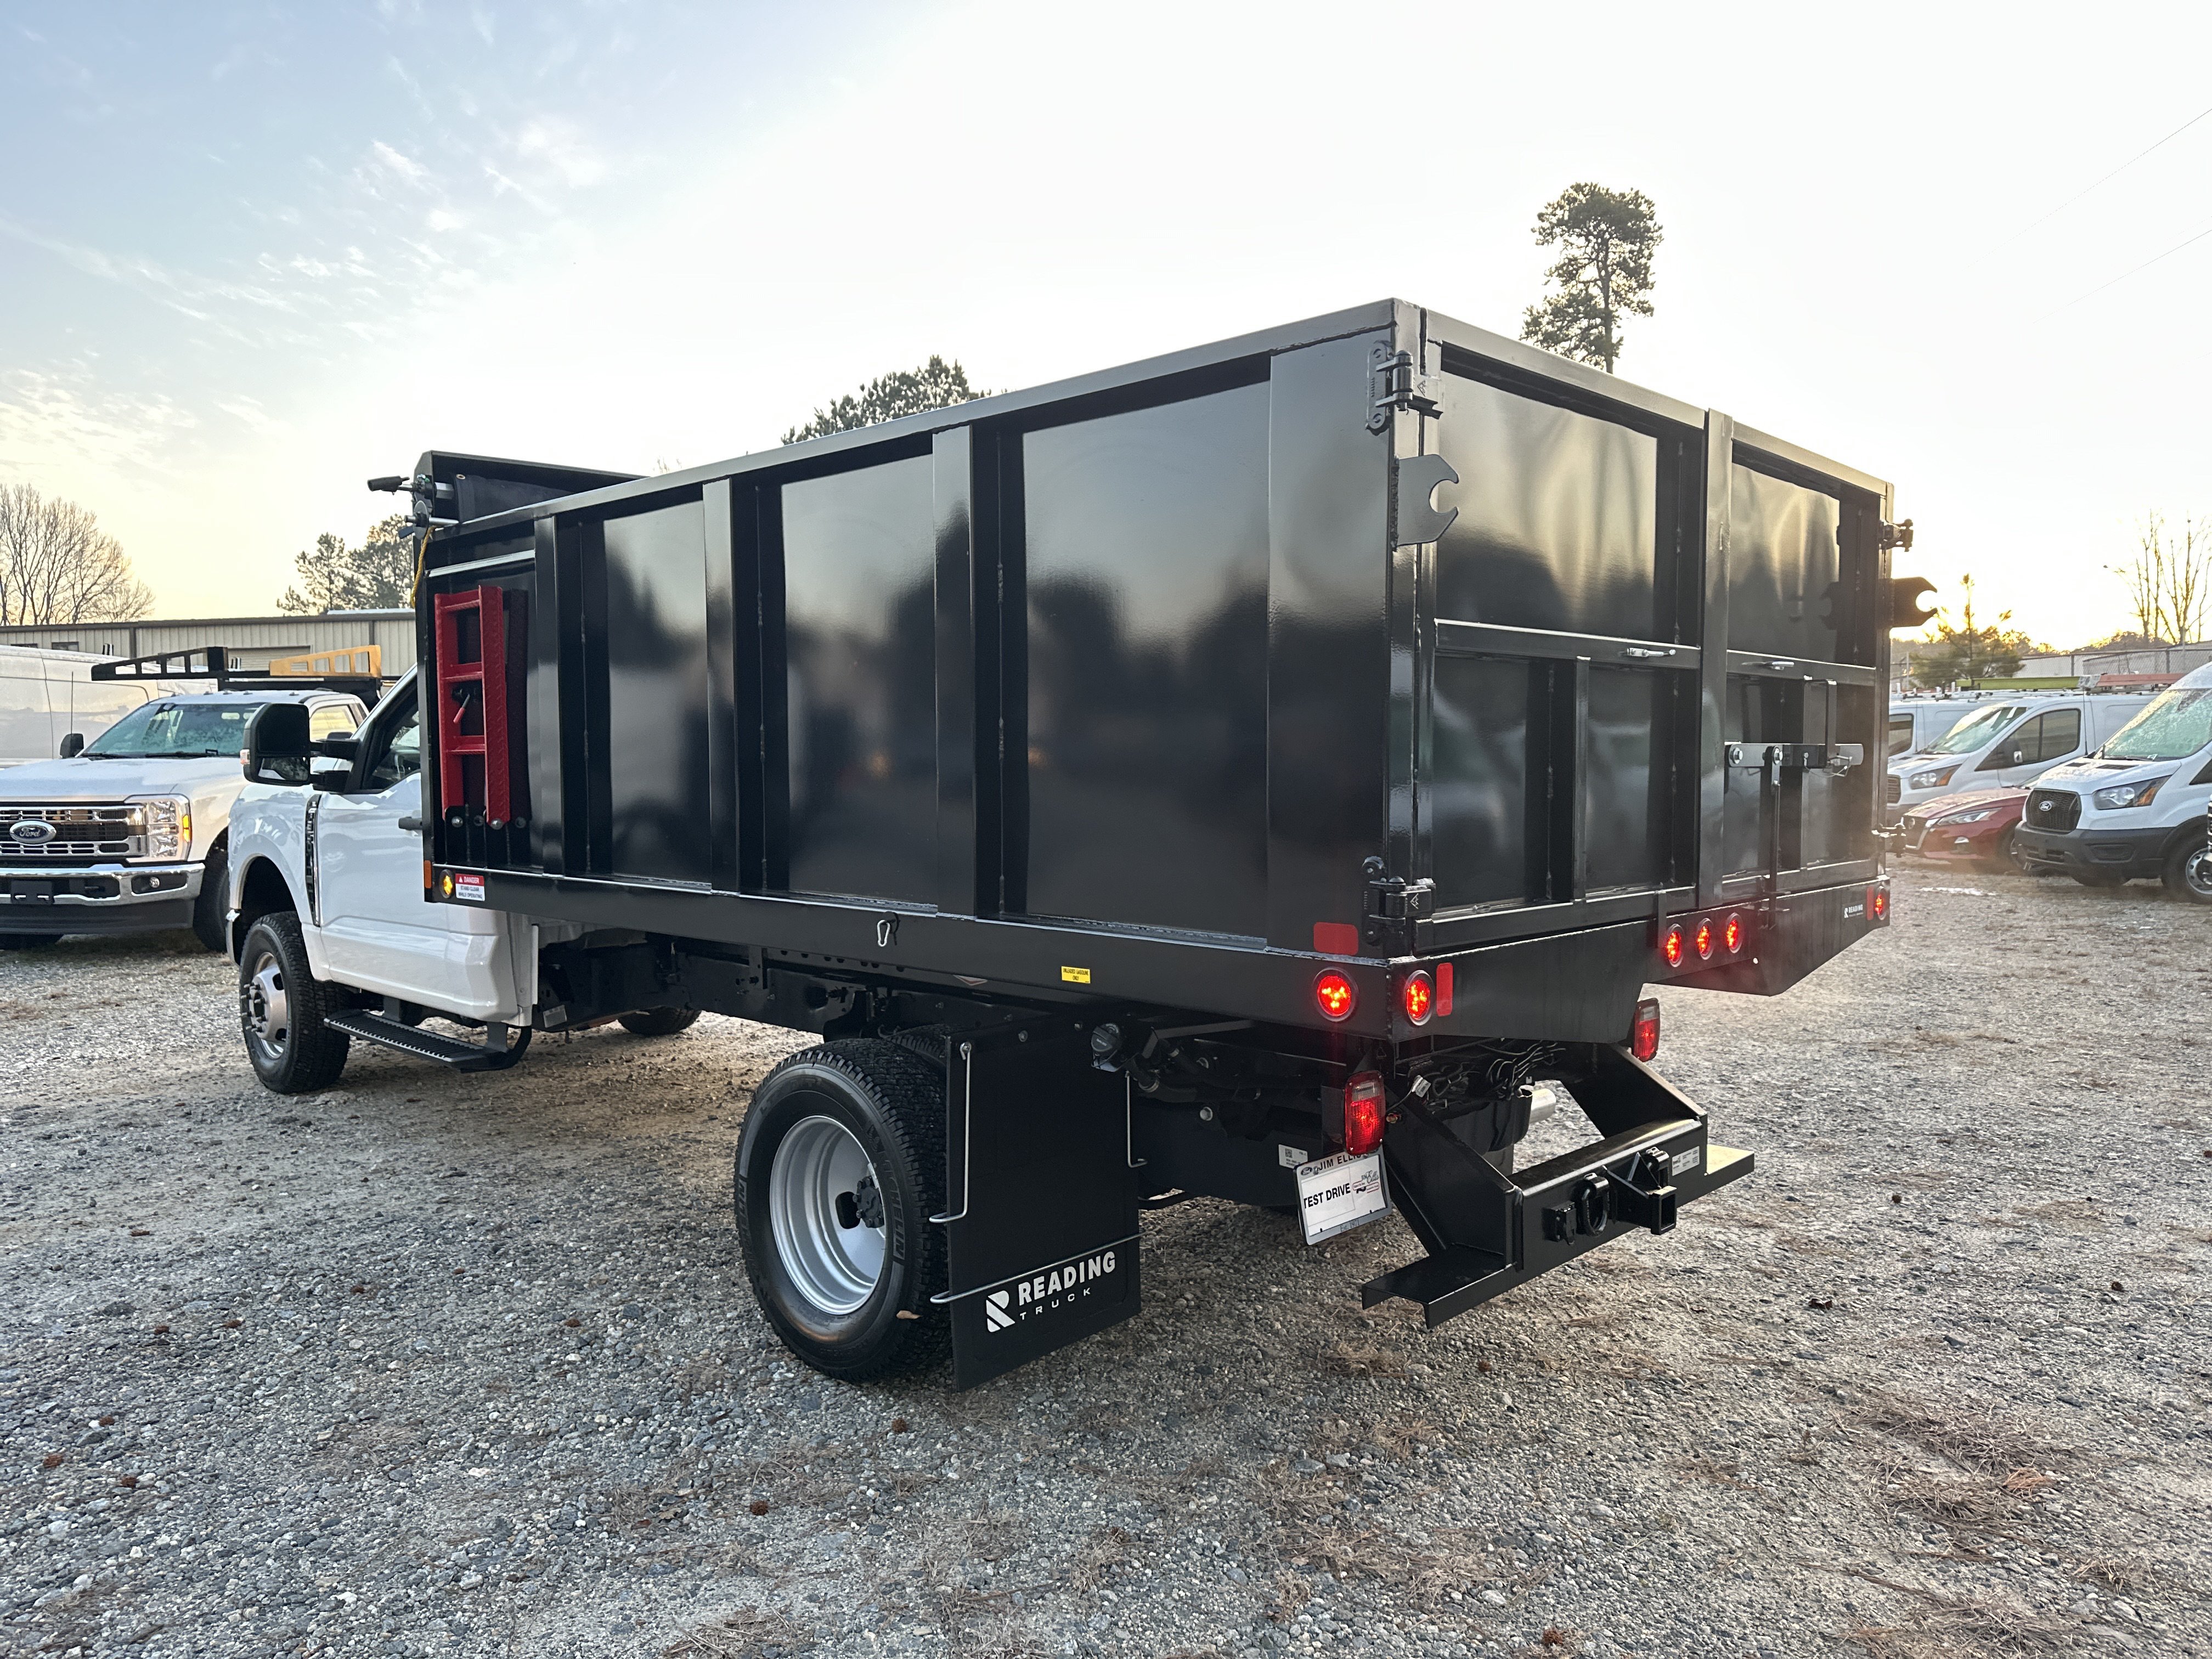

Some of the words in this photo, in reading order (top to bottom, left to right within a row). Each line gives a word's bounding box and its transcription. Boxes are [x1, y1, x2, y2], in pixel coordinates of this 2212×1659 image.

[1317, 1158, 1334, 1171] JIM
[1304, 1192, 1324, 1209] TEST
[1326, 1183, 1351, 1201] DRIVE
[1018, 1251, 1115, 1306] READING
[1019, 1287, 1091, 1320] TRUCK
